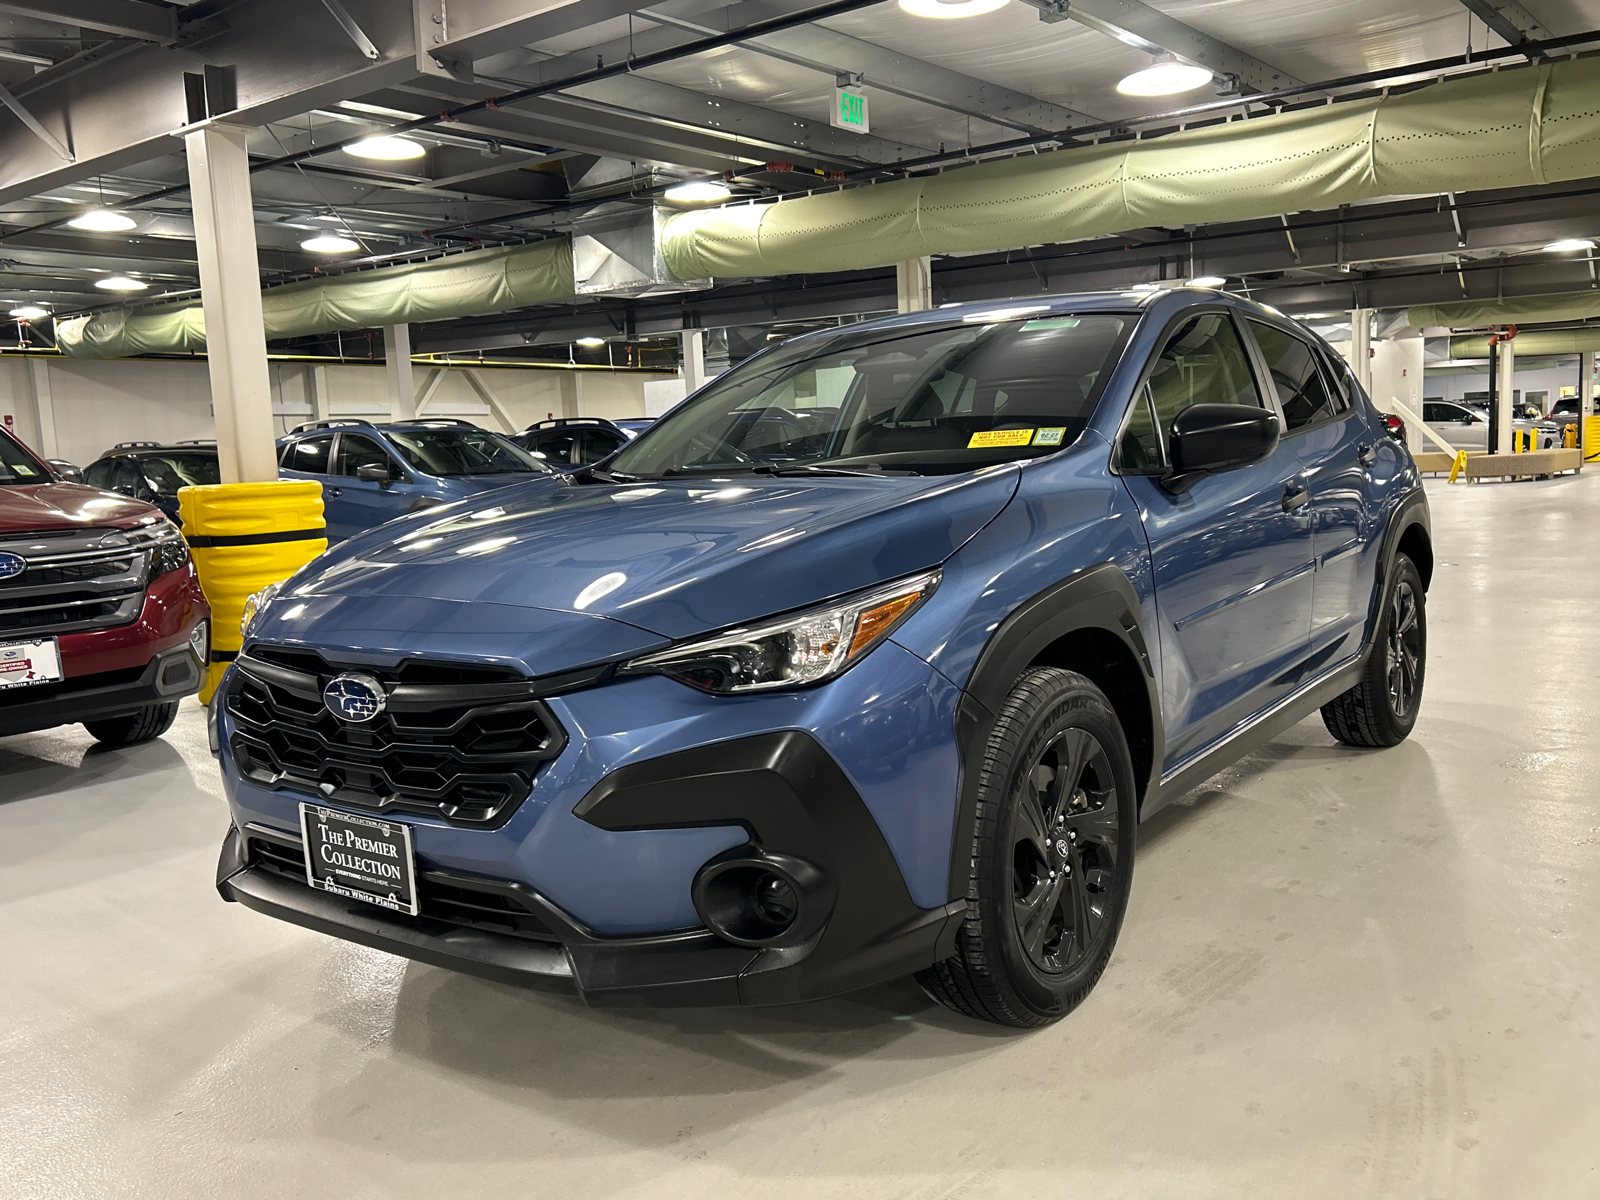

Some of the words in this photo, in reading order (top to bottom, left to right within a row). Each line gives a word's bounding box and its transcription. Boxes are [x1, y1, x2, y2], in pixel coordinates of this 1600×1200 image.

[842, 93, 863, 126] EXIT
[317, 823, 345, 846] THE
[344, 829, 399, 858] PREMIER
[321, 844, 401, 879] COLLECTION
[335, 869, 361, 880] EVERYTHING
[324, 883, 350, 896] Subaru
[351, 890, 373, 902] White
[375, 897, 399, 910] Plains
[1066, 948, 1112, 1007] YOKOHAMA
